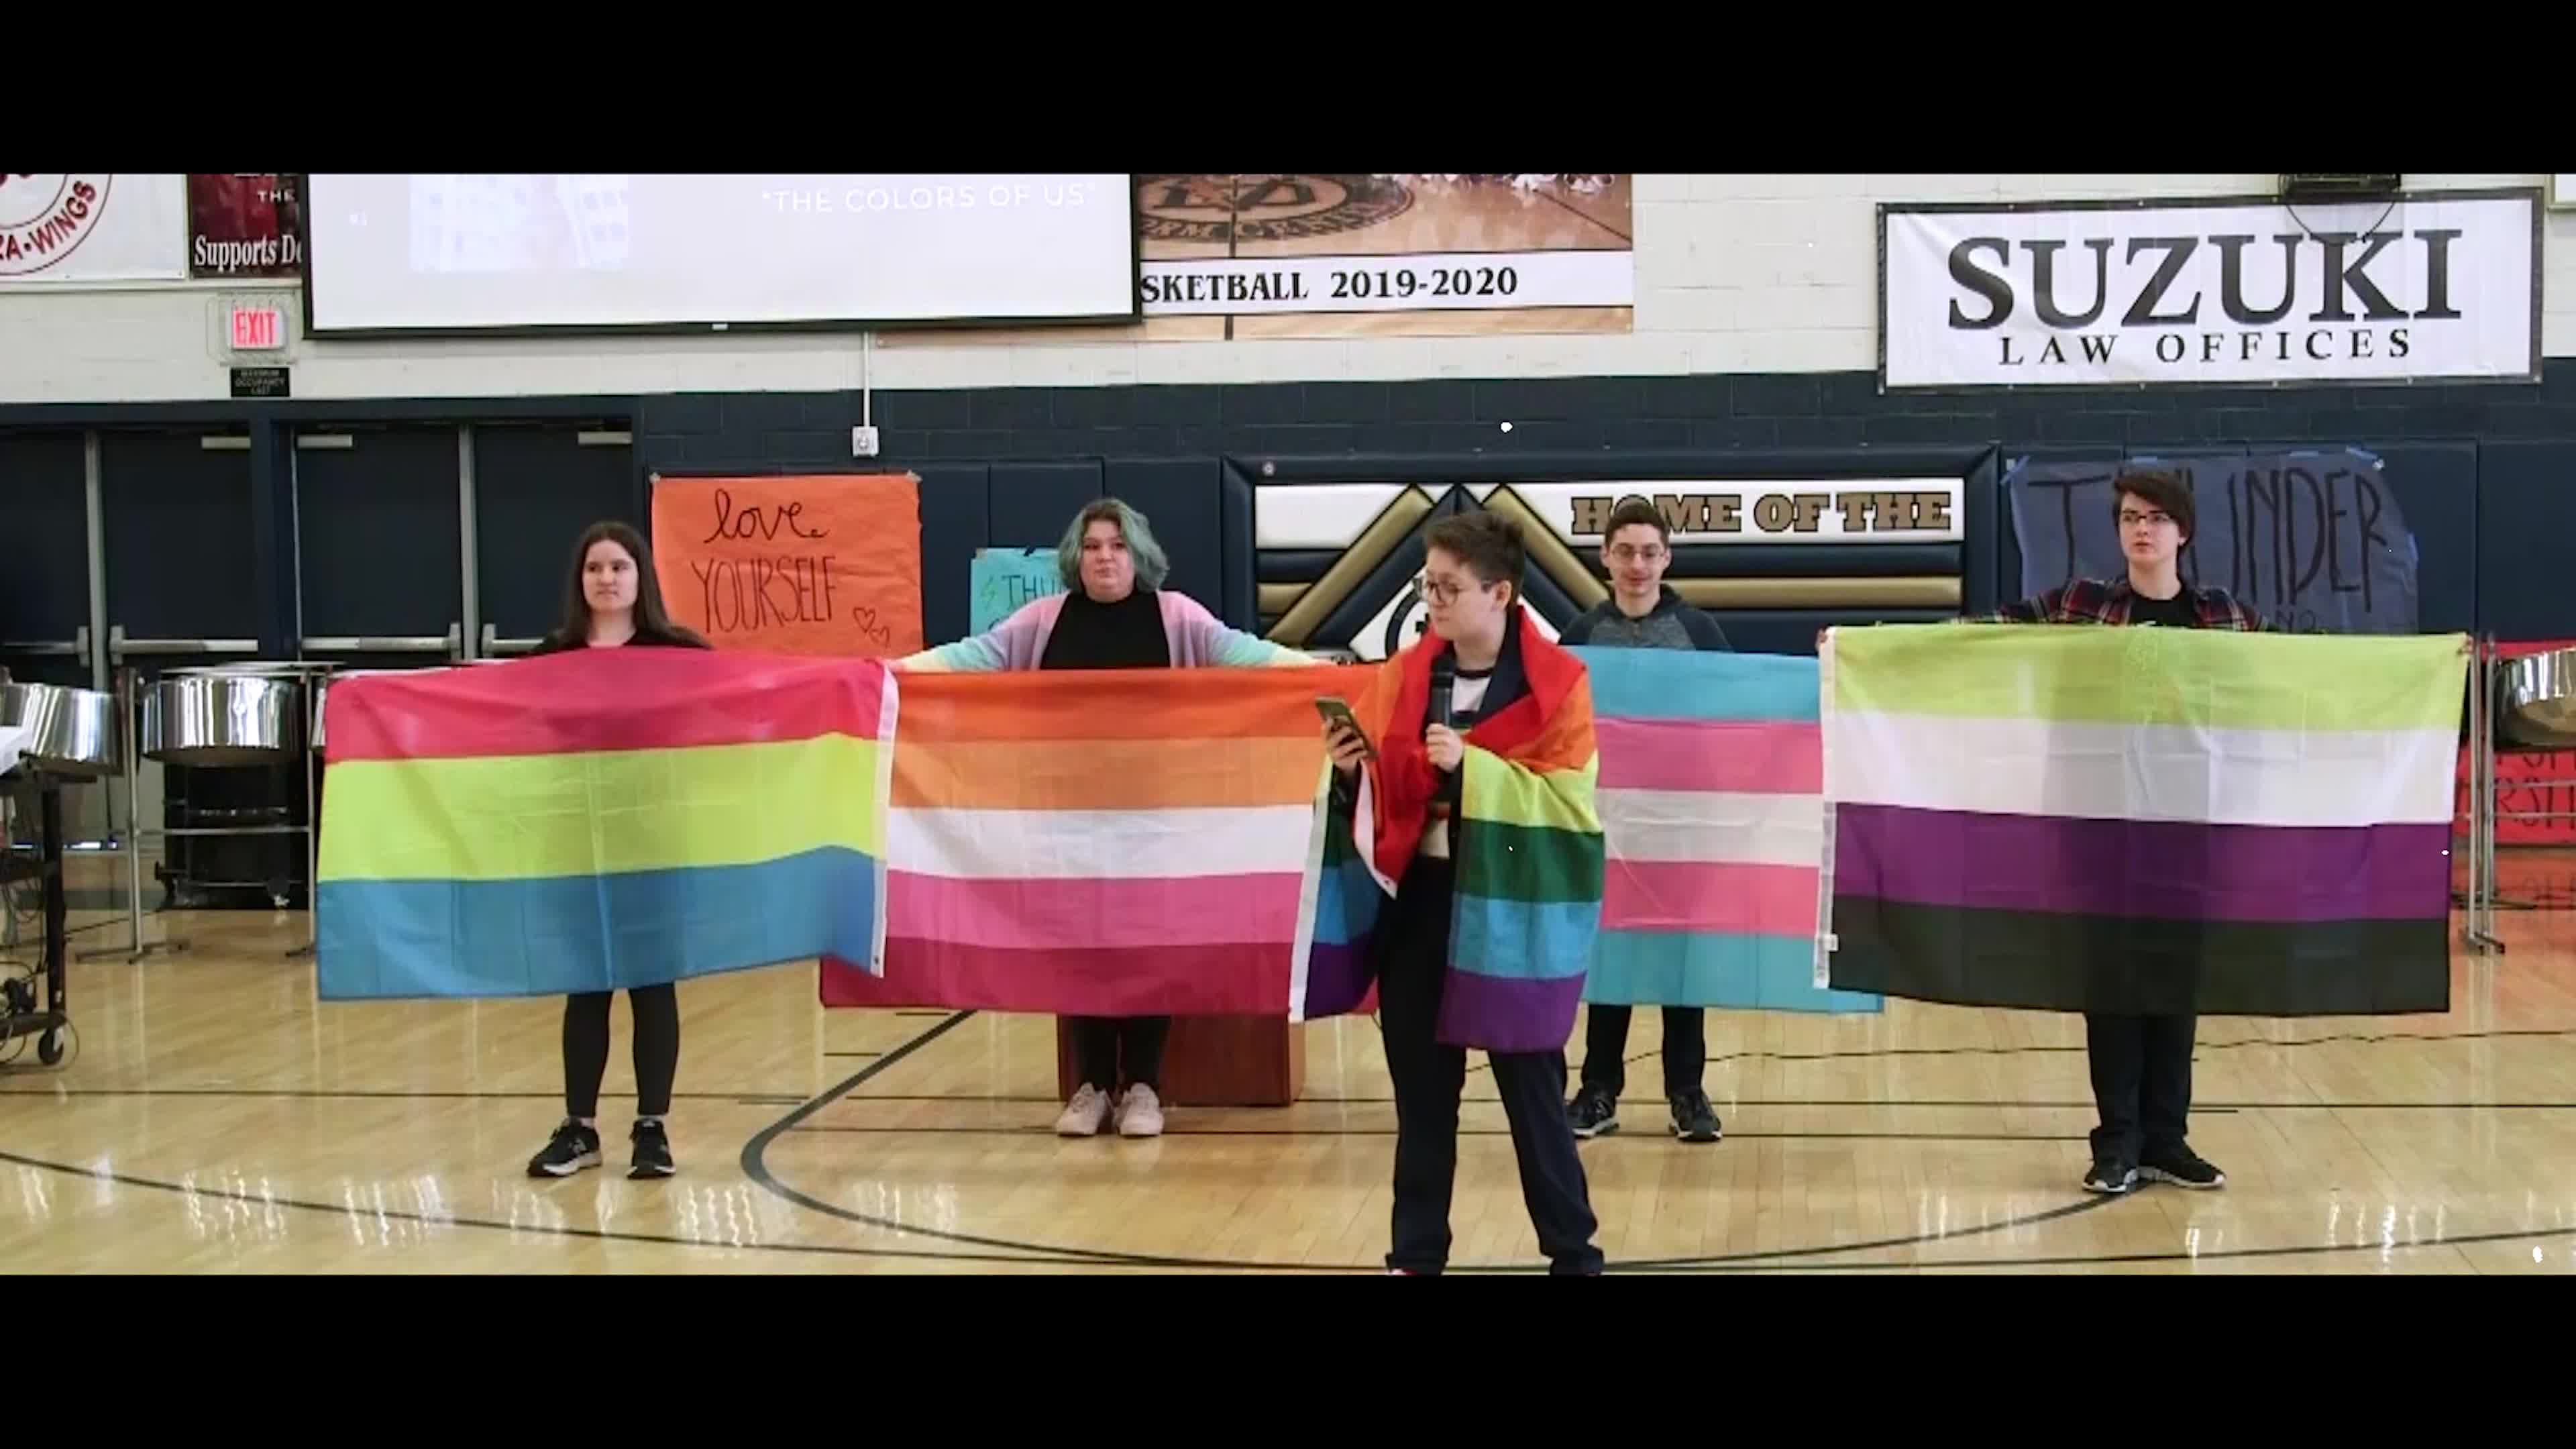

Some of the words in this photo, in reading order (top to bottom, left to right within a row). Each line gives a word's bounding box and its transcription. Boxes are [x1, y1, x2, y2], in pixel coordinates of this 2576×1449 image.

[845, 184, 976, 213] COLORS
[988, 183, 1030, 208] OF
[195, 234, 277, 272] Supports
[1330, 266, 1519, 299] 2019-2020
[1947, 229, 2462, 331] SUZUKI
[236, 312, 276, 345] EXIT
[1998, 334, 2119, 366] LAW
[2155, 327, 2412, 364] OFFICES
[704, 488, 830, 543] love
[1571, 494, 1742, 535] HME
[1754, 494, 1831, 532] OF
[1836, 492, 1951, 532] THE
[691, 555, 837, 634] YOURSELF
